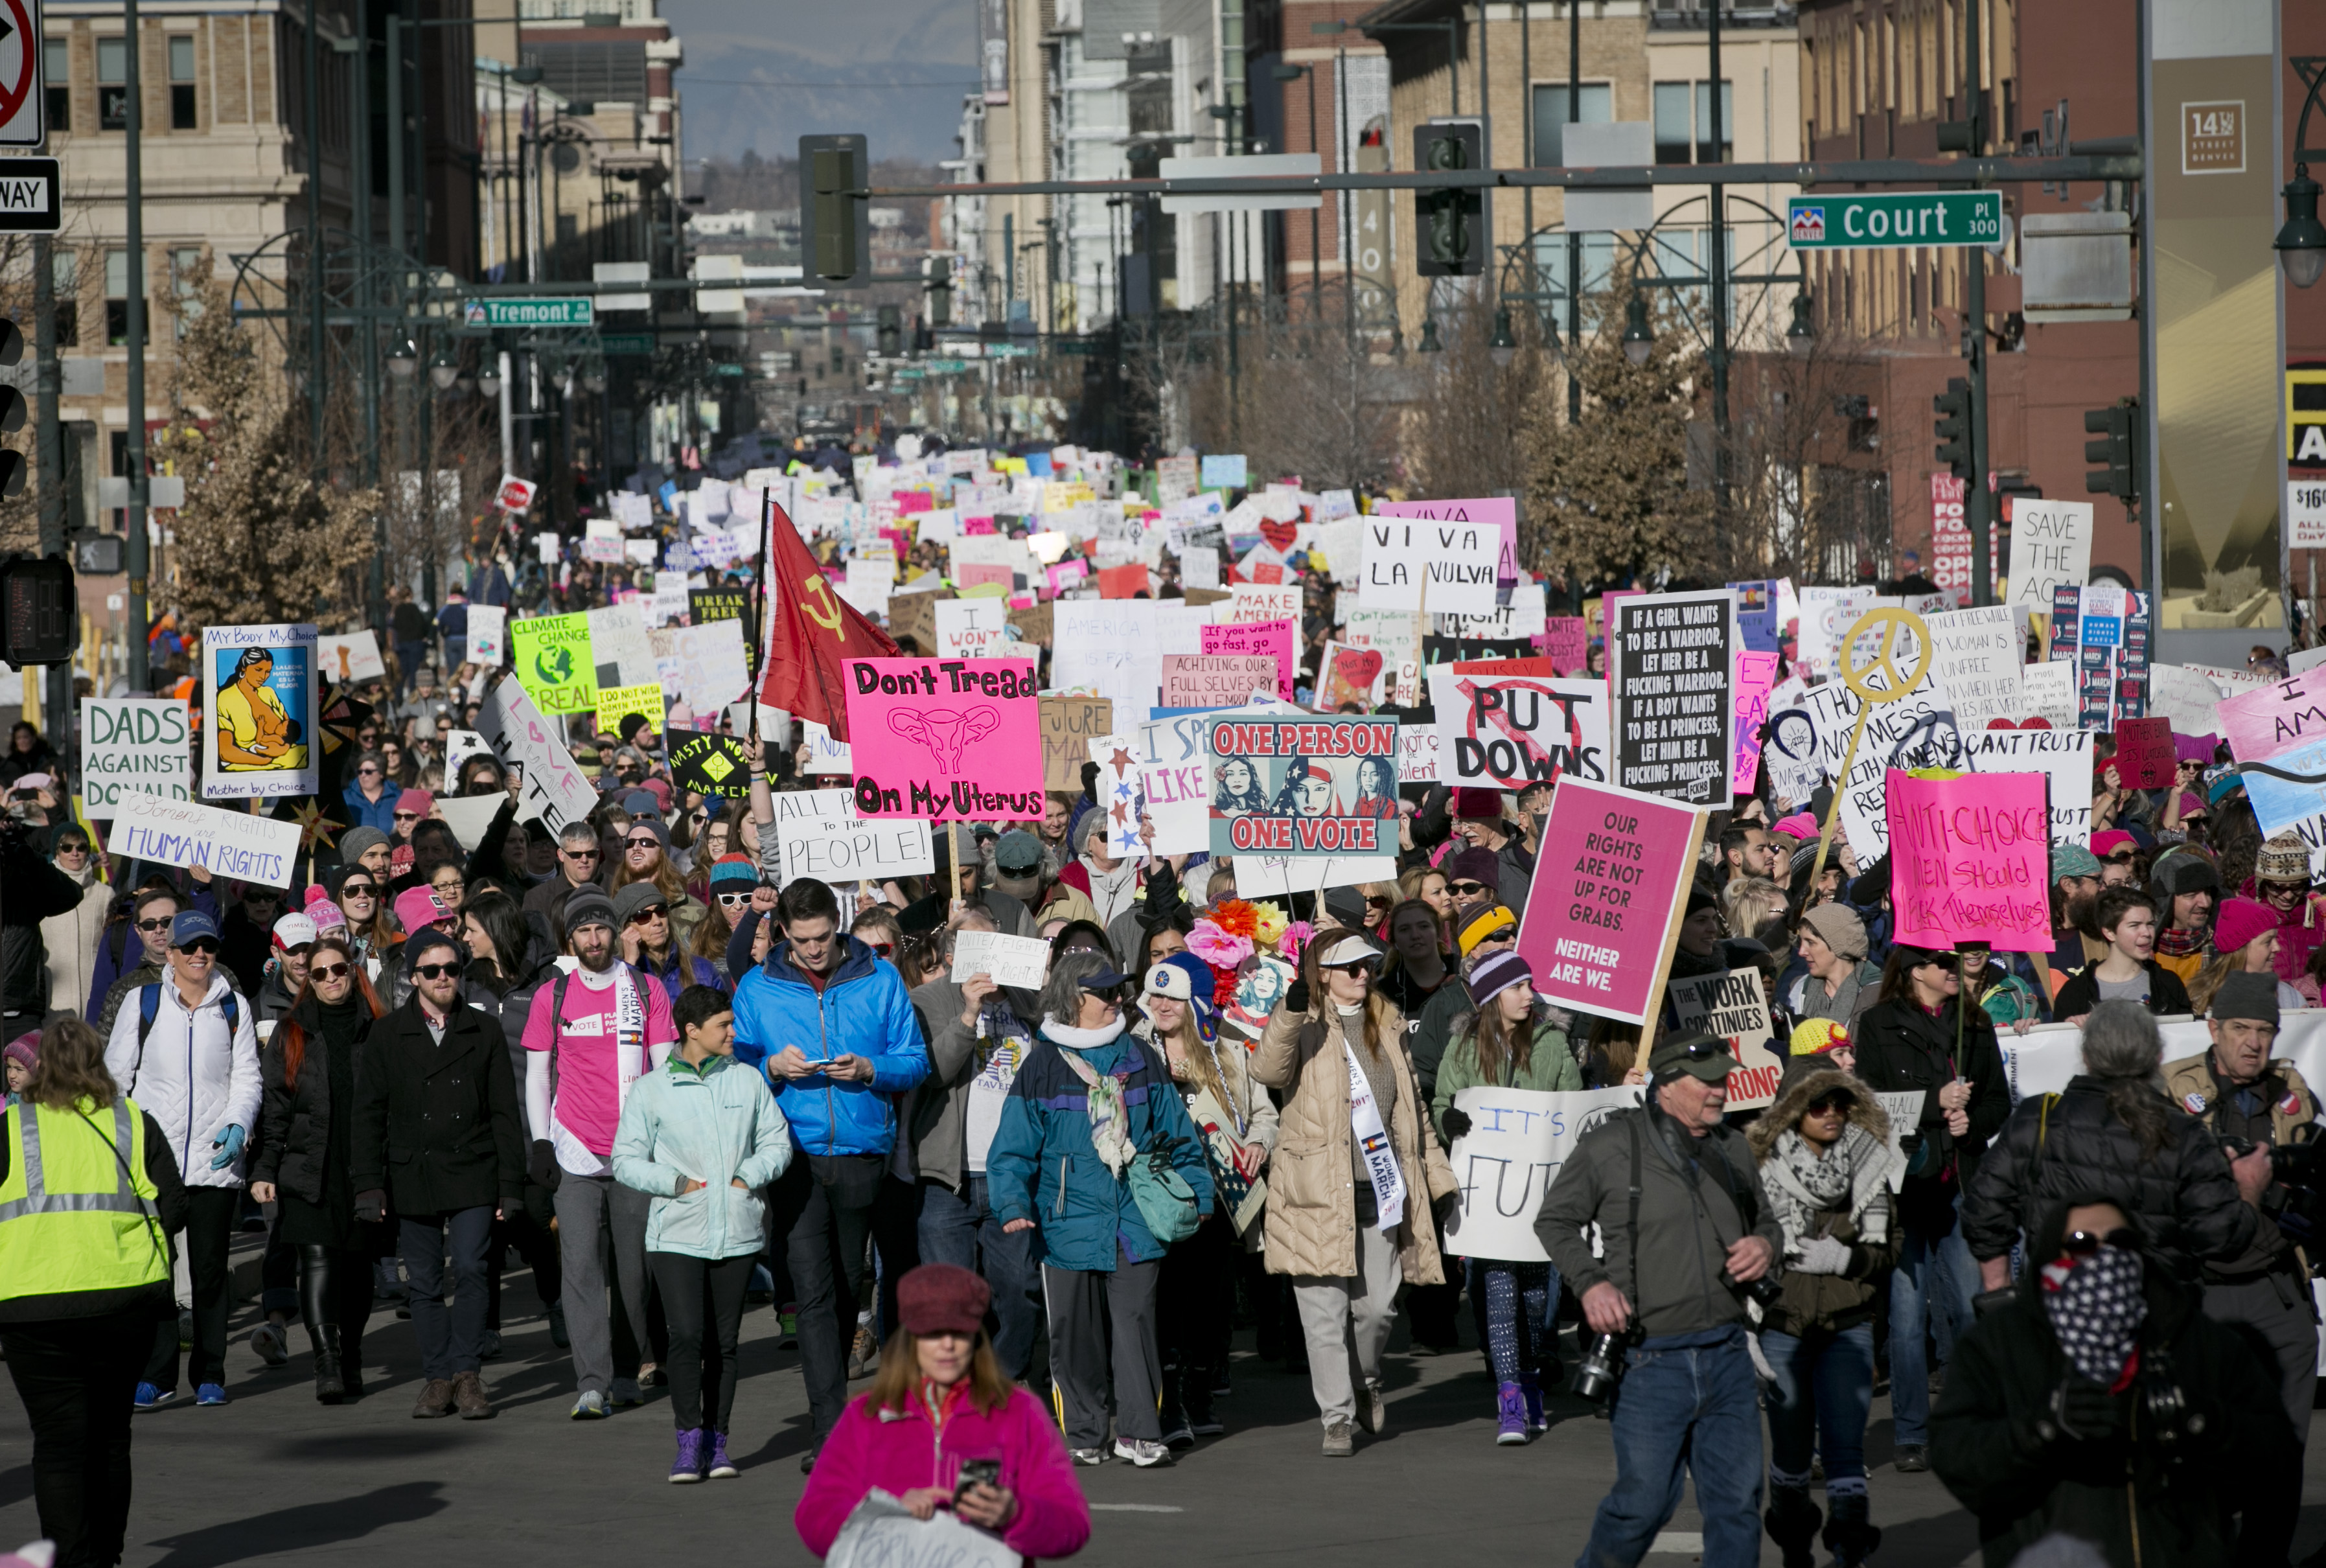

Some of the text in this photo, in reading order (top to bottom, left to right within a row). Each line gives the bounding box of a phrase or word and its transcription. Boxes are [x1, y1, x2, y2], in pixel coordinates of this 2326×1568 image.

[2193, 140, 2234, 150] STREET
[2193, 153, 2234, 161] DENVER
[1844, 202, 1988, 238] Court Pl
[1969, 220, 1997, 235] 300
[490, 303, 570, 321] Tremont
[2024, 512, 2078, 540] SAVE
[2027, 543, 2071, 571] THE
[1372, 560, 1493, 585] LA VULVA
[694, 594, 744, 607] BREAK
[1237, 594, 1295, 609] MAKE
[2055, 595, 2078, 605] MARCH
[701, 606, 739, 618] FREE
[1633, 605, 1718, 628] IF A GIRL WANTS
[1939, 608, 2011, 630] NOT FREE WHILE
[287, 627, 318, 641] Choice
[514, 617, 570, 634] CLIMATE
[538, 628, 590, 645] CHANGE
[1204, 622, 1286, 639] If you want to
[1206, 641, 1219, 654] go
[1253, 639, 1269, 651] go
[1627, 634, 1640, 651] TO
[1644, 632, 1657, 650] BE
[1660, 631, 1667, 649] A
[1670, 627, 1724, 648] WARRIOR,
[1946, 633, 2007, 652] WOMAN IS
[1176, 657, 1267, 672] ACHIVING OUR
[1642, 651, 1709, 672] LET HER BE A
[1941, 657, 1990, 678] UNFREE
[852, 662, 1037, 699] Don't Tread
[1171, 676, 1272, 692] FULL SELVES BY
[1626, 671, 1727, 697] FUCKING WARRIOR.
[1959, 677, 2015, 698] WHEN HER
[540, 686, 597, 711] REAL
[599, 686, 660, 702] I DO NOT WISH
[643, 697, 661, 706] HAVE
[1633, 694, 1716, 717] IF A BOY WANTS
[1474, 687, 1592, 733] PUT
[1980, 697, 2025, 715] ARE VERY
[91, 705, 185, 744] DADS
[1628, 716, 1721, 740] TO BE A PRINCESS,
[1867, 702, 1937, 750] MESS
[1140, 724, 1162, 763] I
[1212, 722, 1396, 757] ONE PERSON
[1641, 739, 1707, 761] LET HIM BE A
[1965, 731, 2085, 756] CANT TRUST
[85, 752, 188, 773] AGAINST
[669, 735, 711, 768] NASTY
[1455, 737, 1605, 782] DOWNS
[1144, 765, 1207, 803] LIKE
[1625, 760, 1722, 785] FUCKING PRINCESS.
[207, 779, 306, 796] Mother by Choice
[855, 776, 1042, 818] On My Uterus
[1690, 781, 1708, 795] FCKH8
[127, 794, 279, 840] Women's RIGHTS
[779, 794, 827, 822] ALL
[1893, 779, 2047, 853] ANTI-CHOICE
[194, 827, 216, 840] are
[842, 820, 868, 830] THE
[1232, 818, 1377, 849] ONE VOTE
[1604, 812, 1637, 835] OUR
[126, 825, 282, 880] HUMAN RIGHTS
[789, 822, 927, 877] PEOPLE!
[1586, 833, 1642, 860] RIGHTS
[1574, 855, 1643, 885] ARE NOT
[1574, 880, 1631, 907] UP FOR
[1569, 904, 1624, 931] GRABS.
[1002, 938, 1048, 954] FIGHT!
[1555, 938, 1620, 968] NEITHER
[982, 954, 999, 964] FOR
[1000, 965, 1042, 986] RIGHTS!
[1549, 962, 1611, 991] ARE WE.
[1675, 973, 1759, 1010] THE WORK
[572, 1021, 597, 1031] VOTE
[1685, 1008, 1764, 1035] CONTINUES
[1479, 1106, 1565, 1136] IT'S
[1370, 1155, 1392, 1201] MARCH
[1383, 1155, 1399, 1193] WOMEN'S
[1384, 1200, 1399, 1216] 2017
